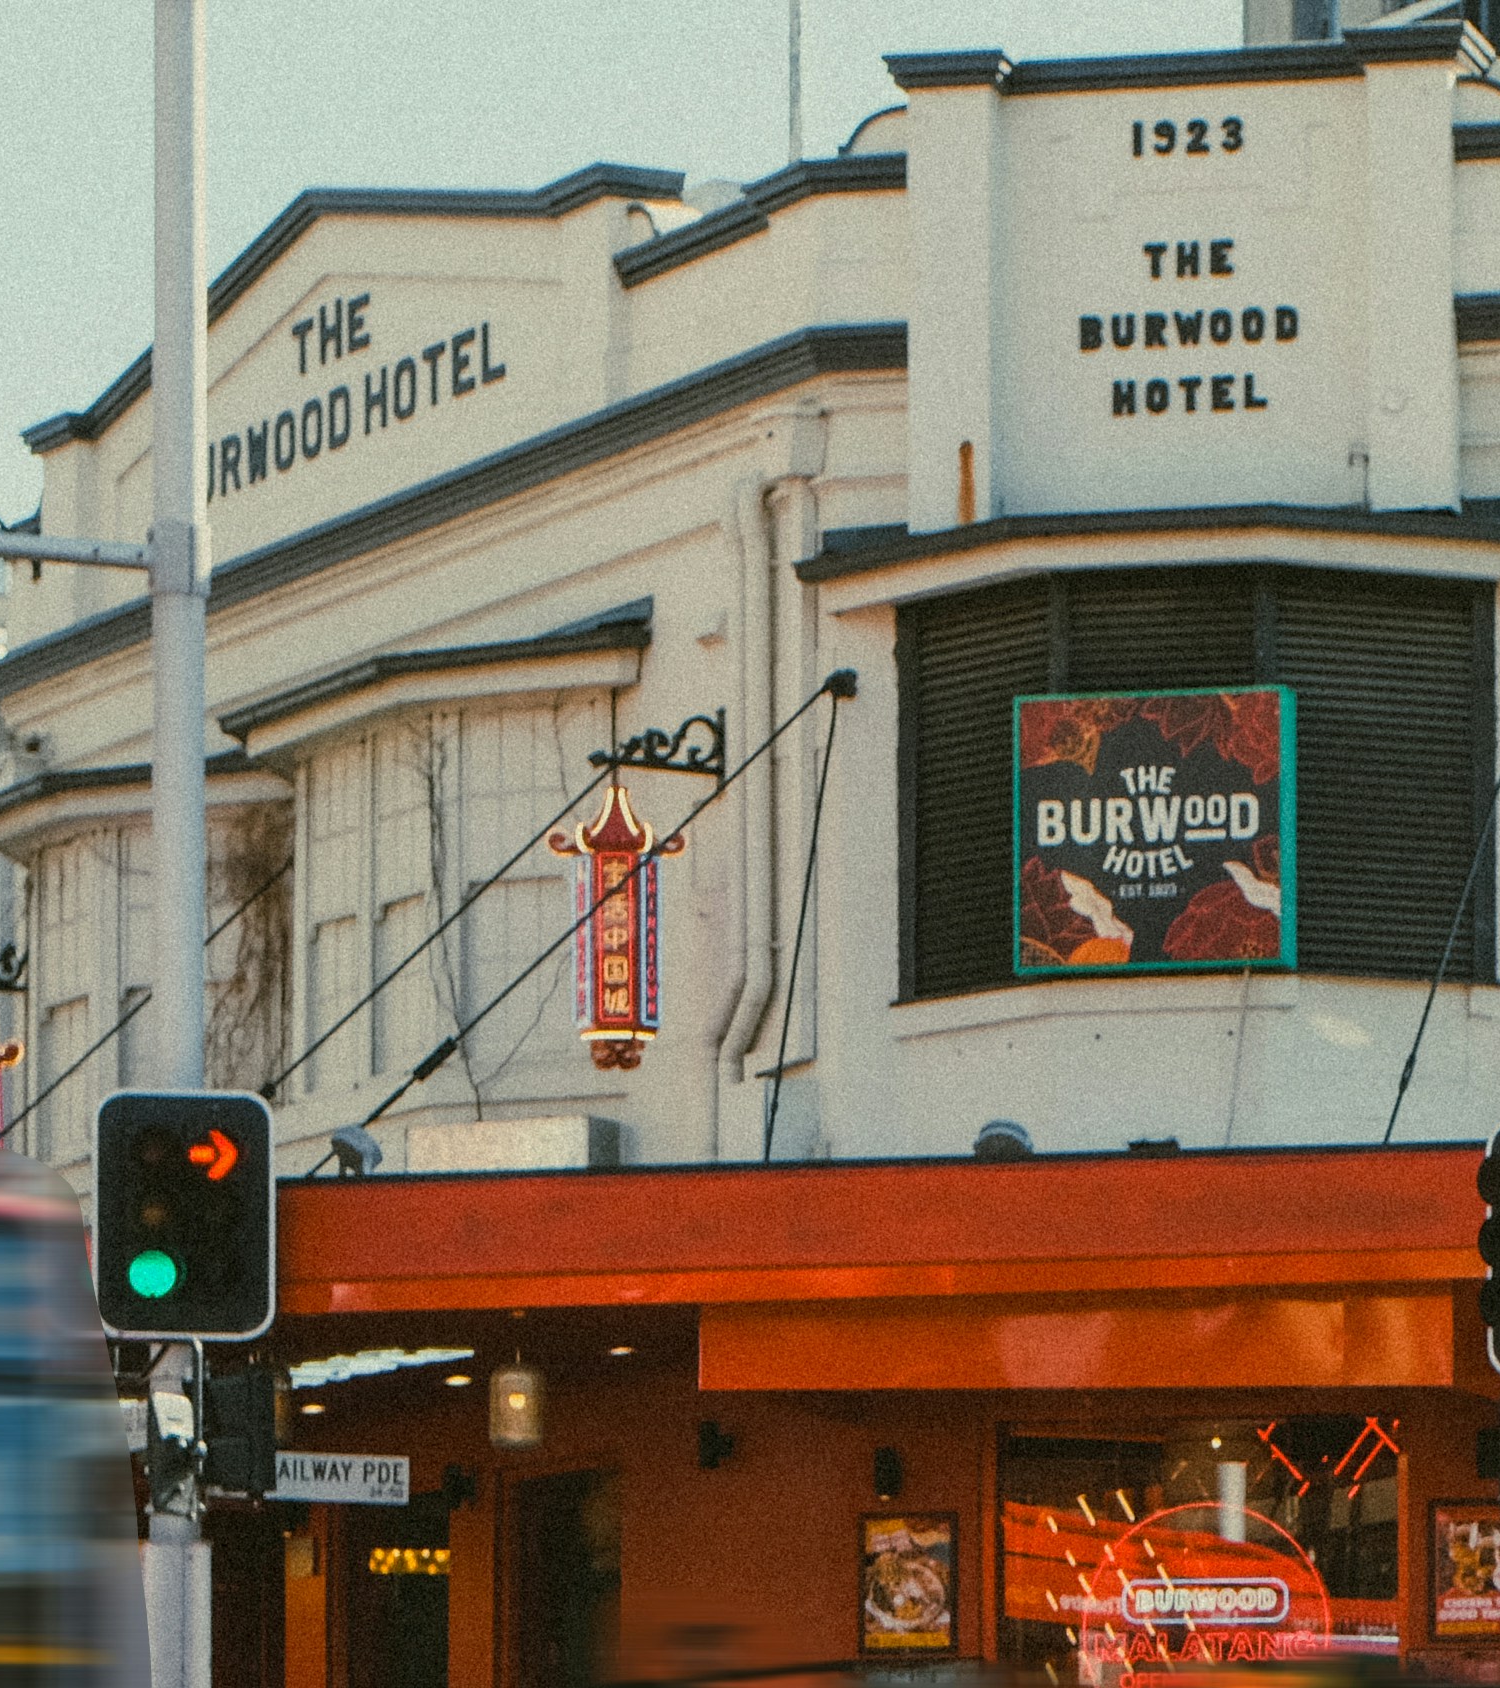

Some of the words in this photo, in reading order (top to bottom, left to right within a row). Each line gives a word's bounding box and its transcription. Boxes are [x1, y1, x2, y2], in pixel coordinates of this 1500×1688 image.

[1132, 115, 1244, 157] 1923
[1143, 238, 1235, 280] THE
[291, 292, 371, 375] THE
[1079, 304, 1298, 352] BURWOOD
[207, 384, 350, 503] RWOOD
[364, 320, 506, 436] HOTEL
[1112, 372, 1268, 416] HOTEL
[1120, 764, 1176, 796] THE
[1037, 792, 1260, 848] BURWOOD
[1103, 844, 1194, 880] HOTEL
[278, 1458, 352, 1484] AILWAY
[362, 1461, 404, 1485] PDE
[1135, 1587, 1277, 1613] BURWOOD
[1094, 1631, 1318, 1663] MALATANG
